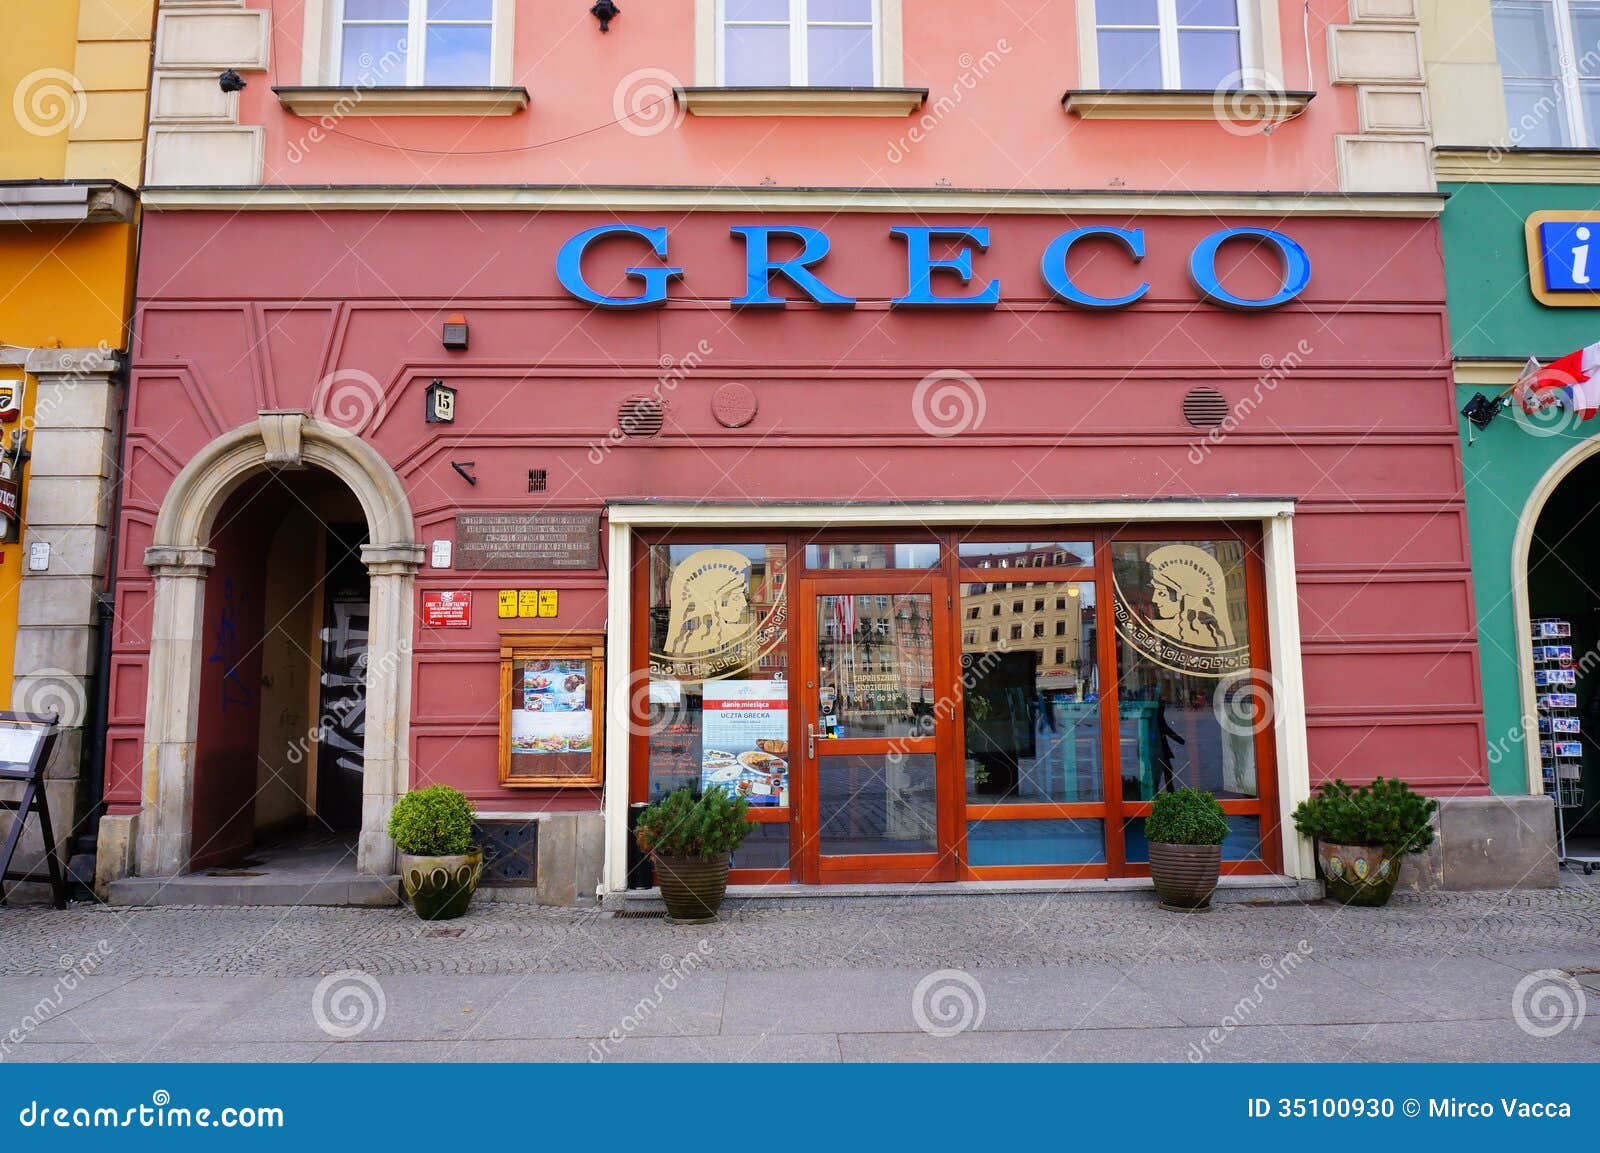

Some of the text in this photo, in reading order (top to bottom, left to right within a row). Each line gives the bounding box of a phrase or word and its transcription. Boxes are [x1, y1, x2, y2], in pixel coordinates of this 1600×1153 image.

[555, 224, 1311, 309] GRECO
[437, 393, 450, 410] 15
[501, 595, 507, 603] W
[541, 595, 548, 603] W
